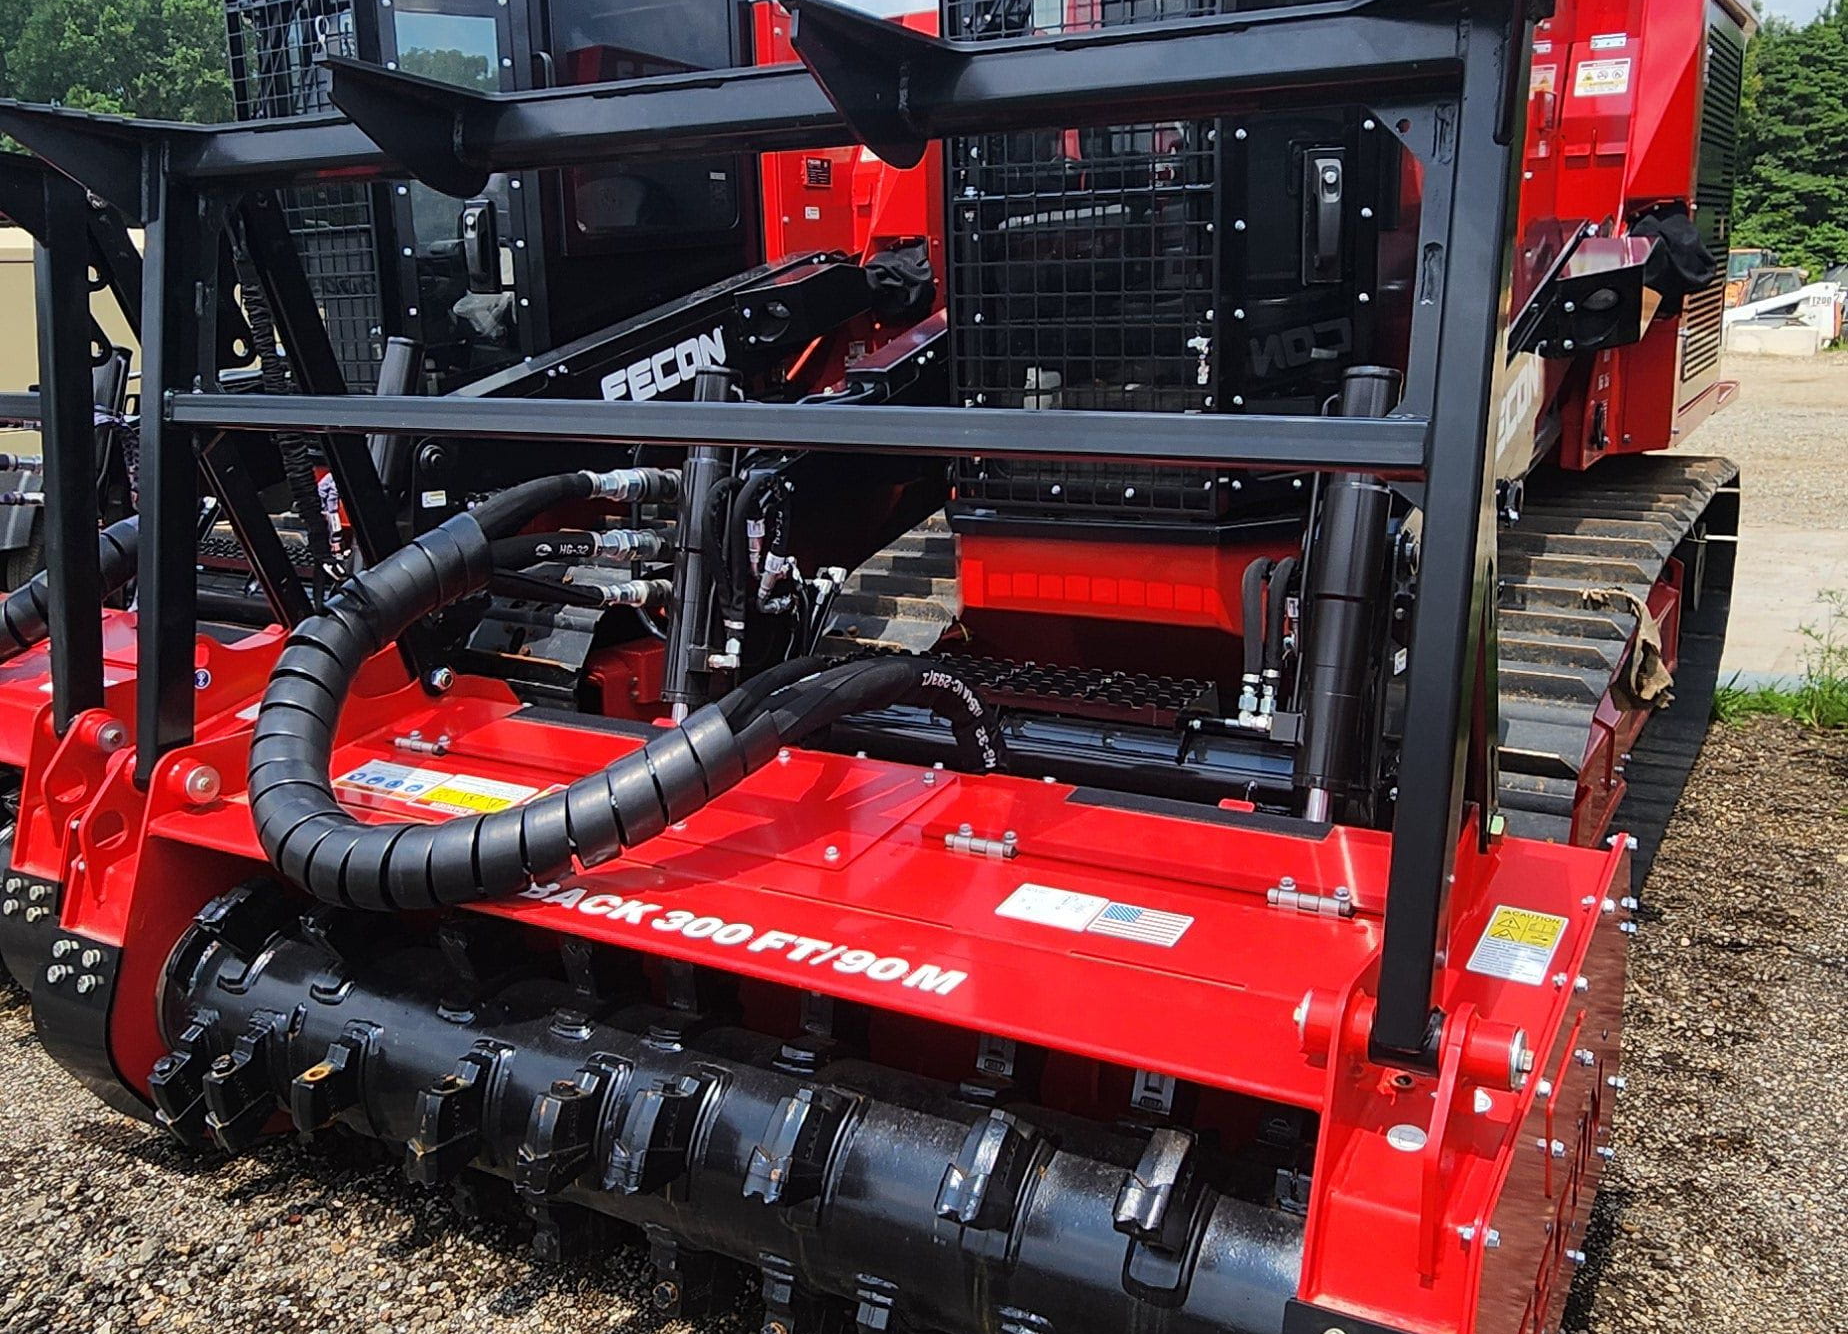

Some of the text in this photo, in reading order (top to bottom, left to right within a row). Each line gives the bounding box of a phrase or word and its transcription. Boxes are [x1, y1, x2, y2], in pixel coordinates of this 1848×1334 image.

[601, 327, 727, 401] FECON
[559, 543, 590, 556] HG-32
[975, 725, 997, 769] HG-32
[518, 882, 968, 995] BACK 300 FT/90 M
[1512, 910, 1560, 924] CAUTION
